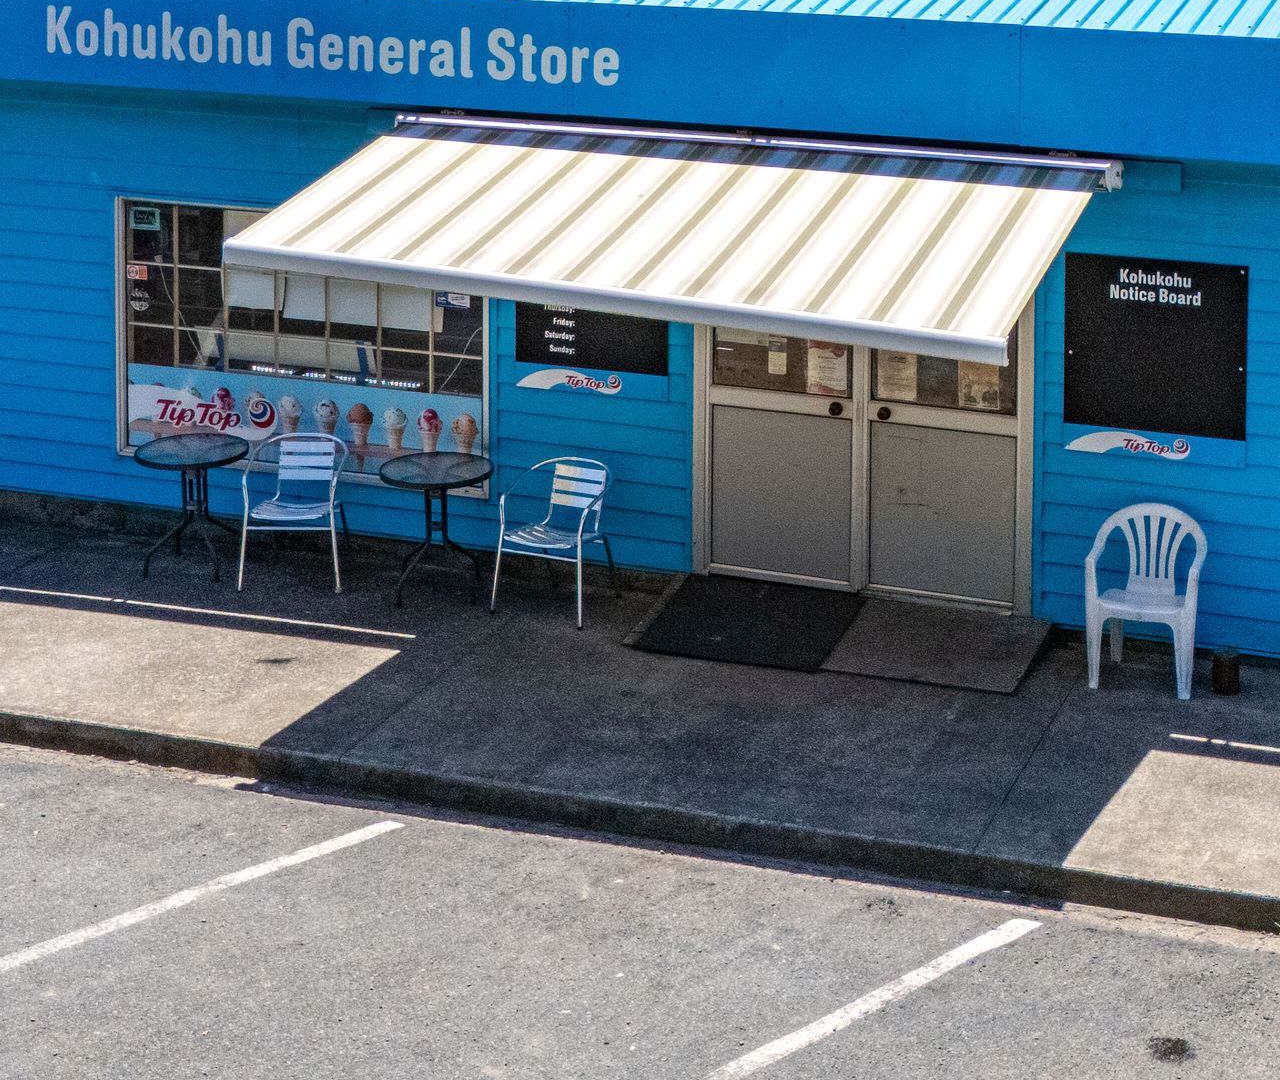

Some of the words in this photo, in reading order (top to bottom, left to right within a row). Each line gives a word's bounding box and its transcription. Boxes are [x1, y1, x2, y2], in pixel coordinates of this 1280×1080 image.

[46, 4, 272, 66] Kohukohu
[287, 17, 474, 79] General
[486, 27, 620, 86] Store
[1120, 268, 1191, 288] Kohukohu
[1110, 284, 1156, 302] Notice
[1159, 288, 1201, 306] Board
[553, 317, 575, 328] Friday:
[544, 330, 575, 341] Saturday:
[549, 344, 575, 355] Sunday:
